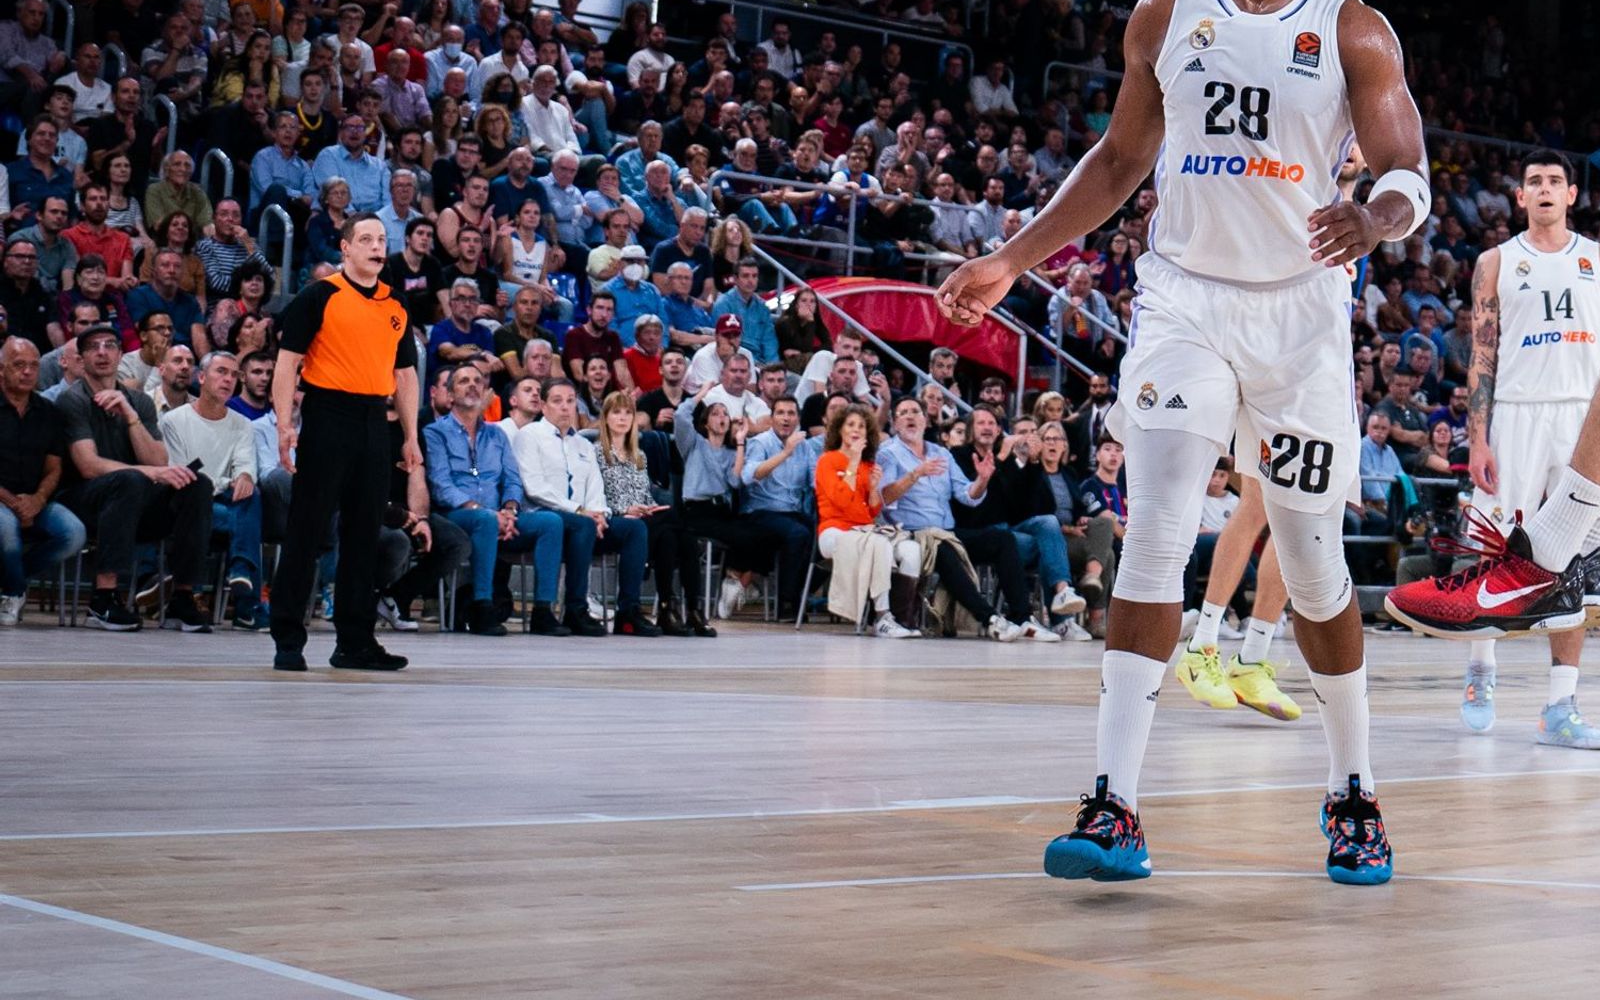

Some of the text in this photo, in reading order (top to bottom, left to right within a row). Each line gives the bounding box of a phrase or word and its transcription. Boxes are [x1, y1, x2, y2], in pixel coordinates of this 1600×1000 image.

[1287, 66, 1320, 80] oneteam
[1204, 81, 1271, 141] 28
[1541, 288, 1574, 321] 14
[1521, 331, 1596, 347] AUTOHERO
[1270, 433, 1334, 494] 28
